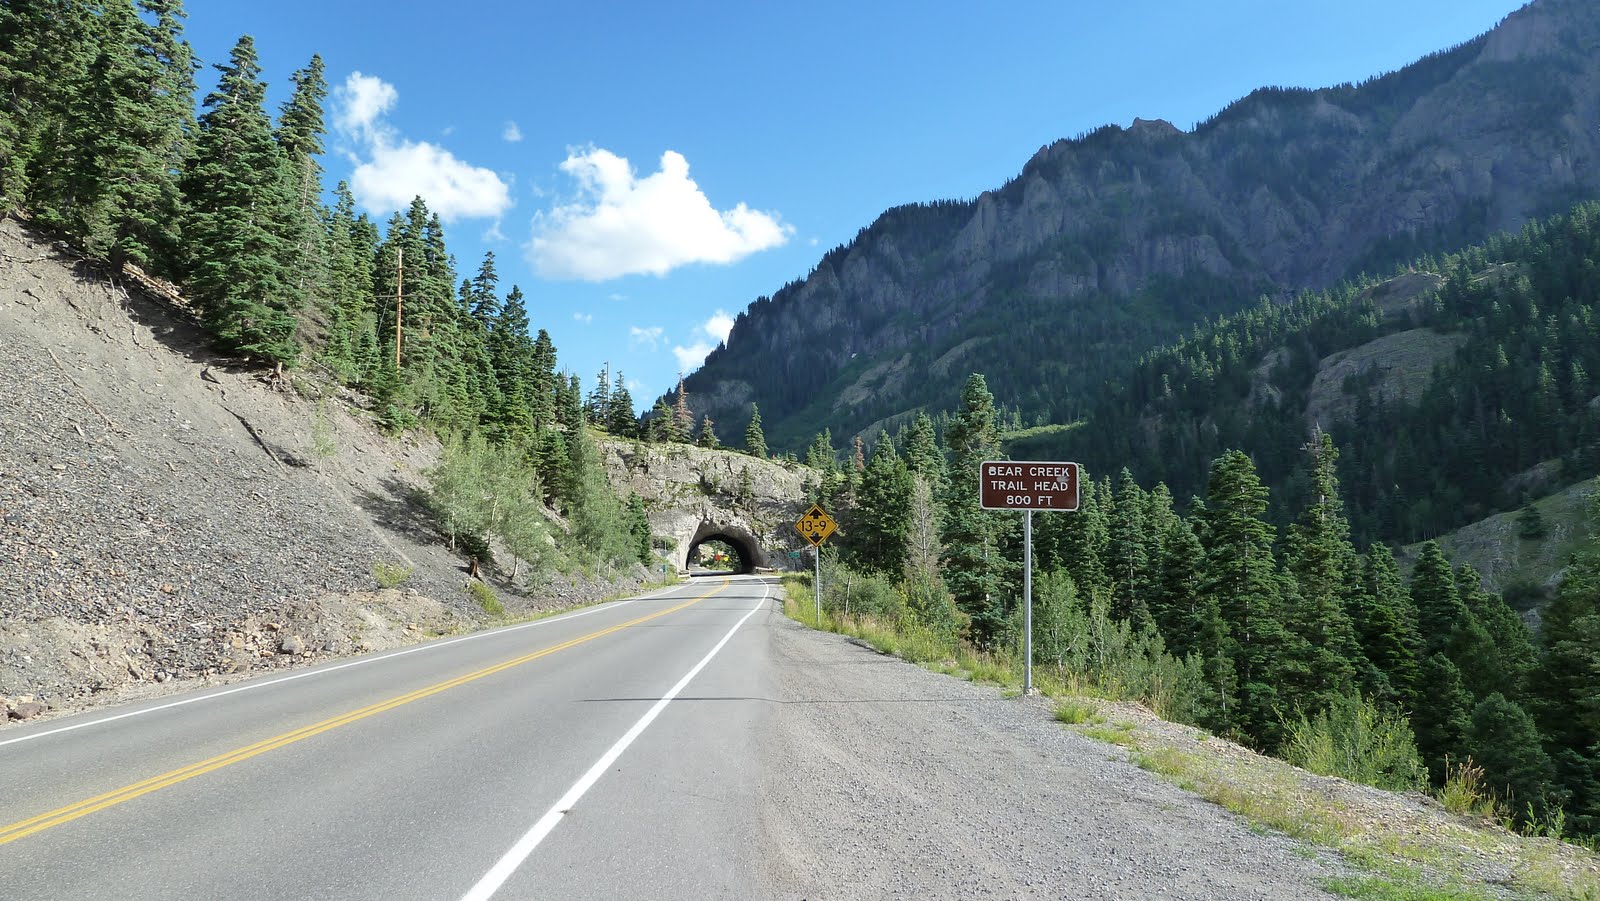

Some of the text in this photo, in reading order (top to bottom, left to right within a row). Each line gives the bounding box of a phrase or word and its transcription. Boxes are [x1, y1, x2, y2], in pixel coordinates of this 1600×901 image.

[988, 466, 1070, 477] BEAR CREEK
[991, 480, 1068, 491] TRAIL HEAD
[1006, 495, 1053, 505] 800 FT
